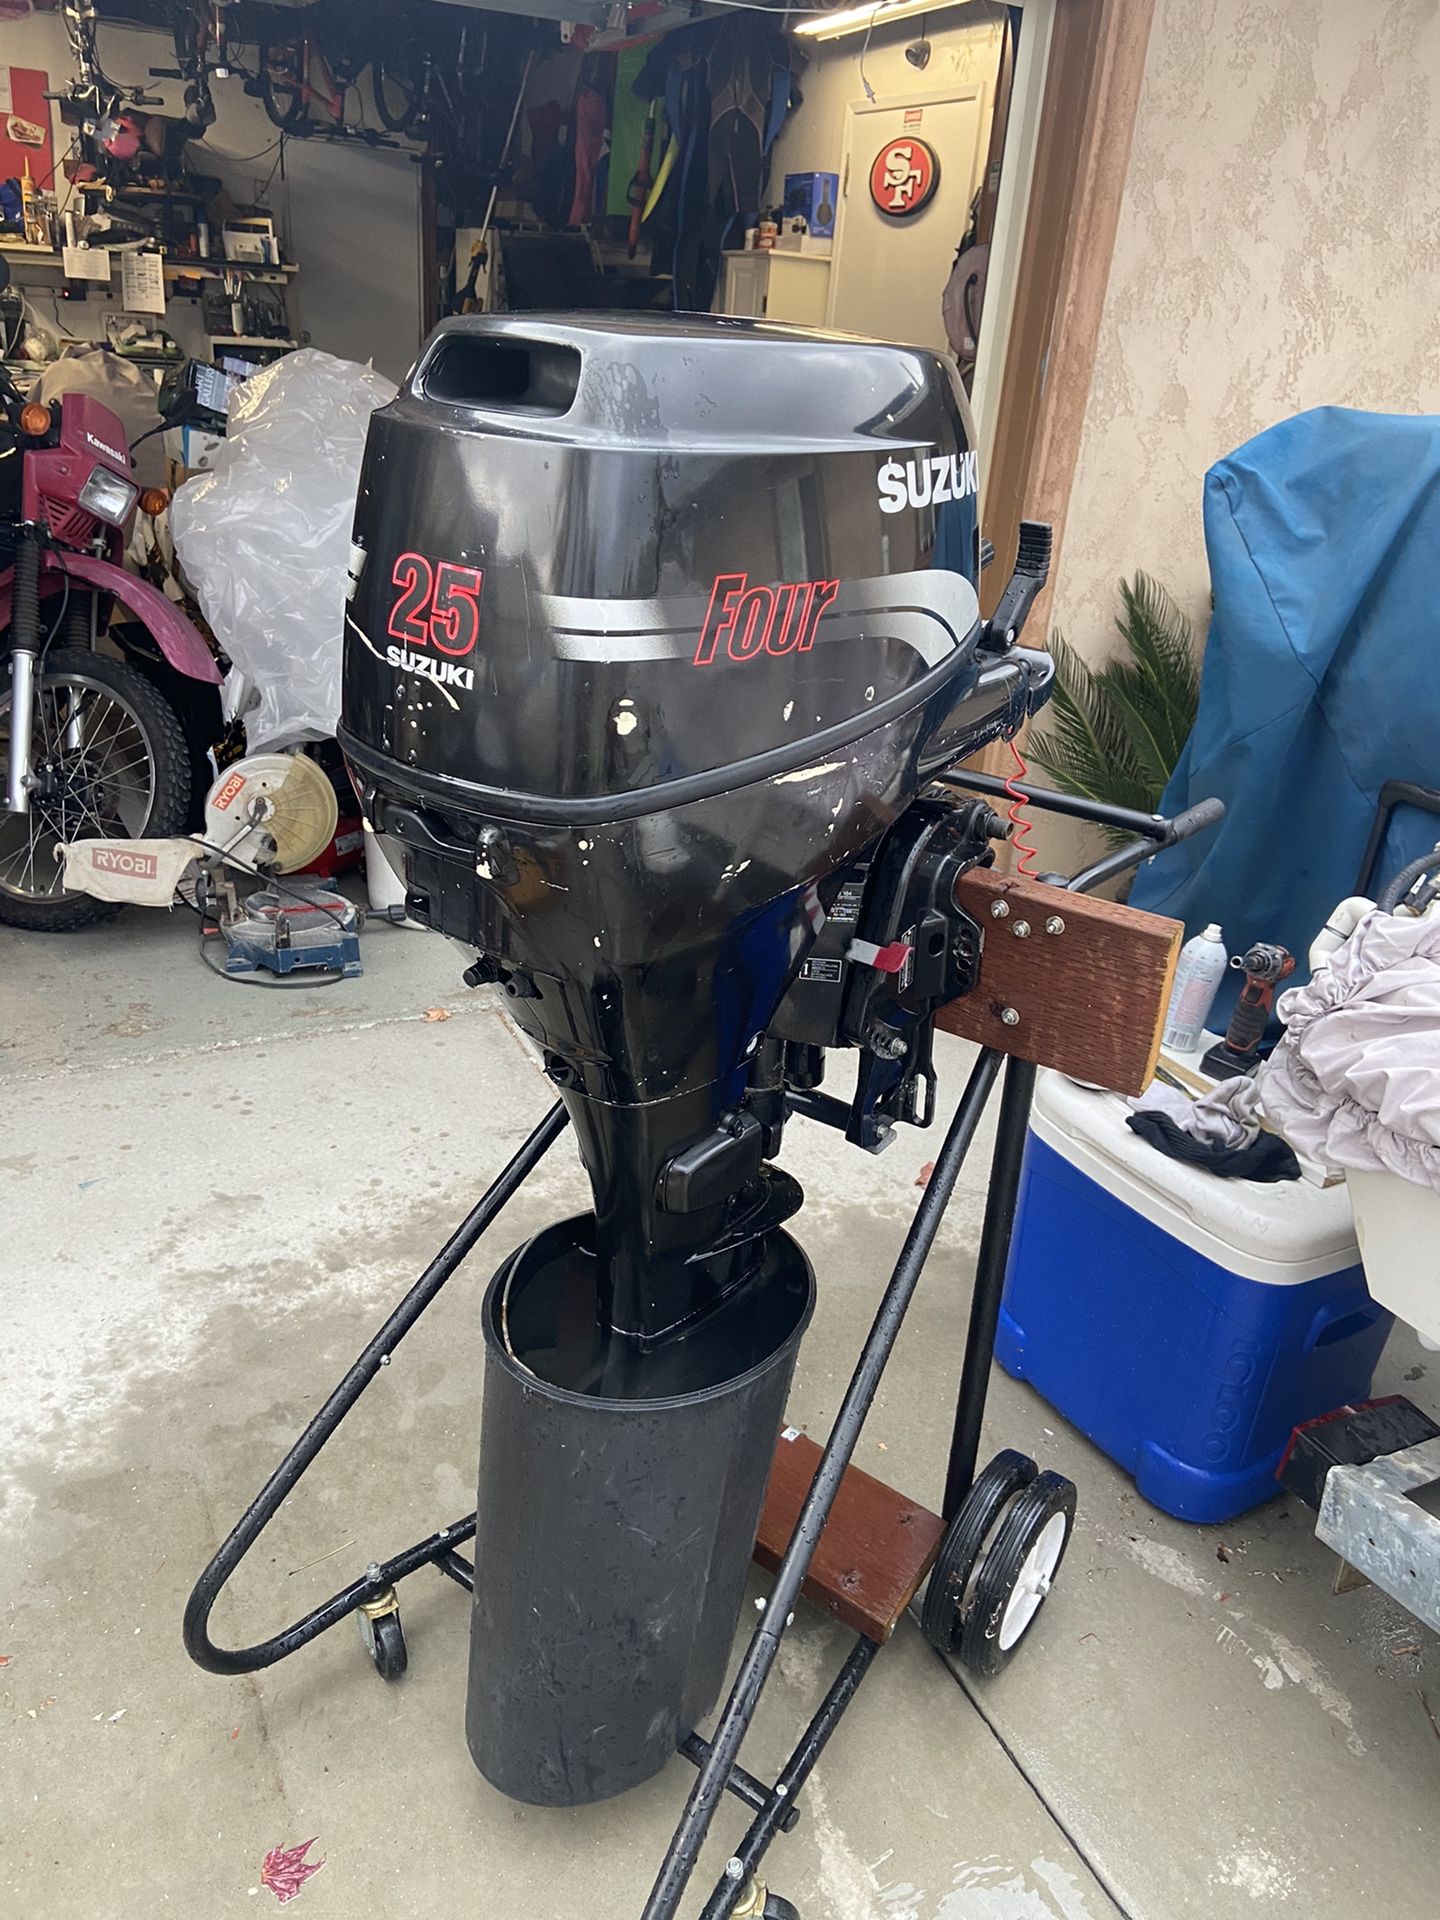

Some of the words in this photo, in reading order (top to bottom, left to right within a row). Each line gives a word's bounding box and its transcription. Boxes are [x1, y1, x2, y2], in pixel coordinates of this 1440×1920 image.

[195, 372, 204, 393] ART
[201, 364, 216, 406] GALLERY
[87, 431, 126, 464] Kawasaki
[387, 552, 482, 656] 25
[386, 645, 475, 690] SUZUKI
[214, 775, 244, 809] RYOBI
[96, 850, 153, 875] RYOBI
